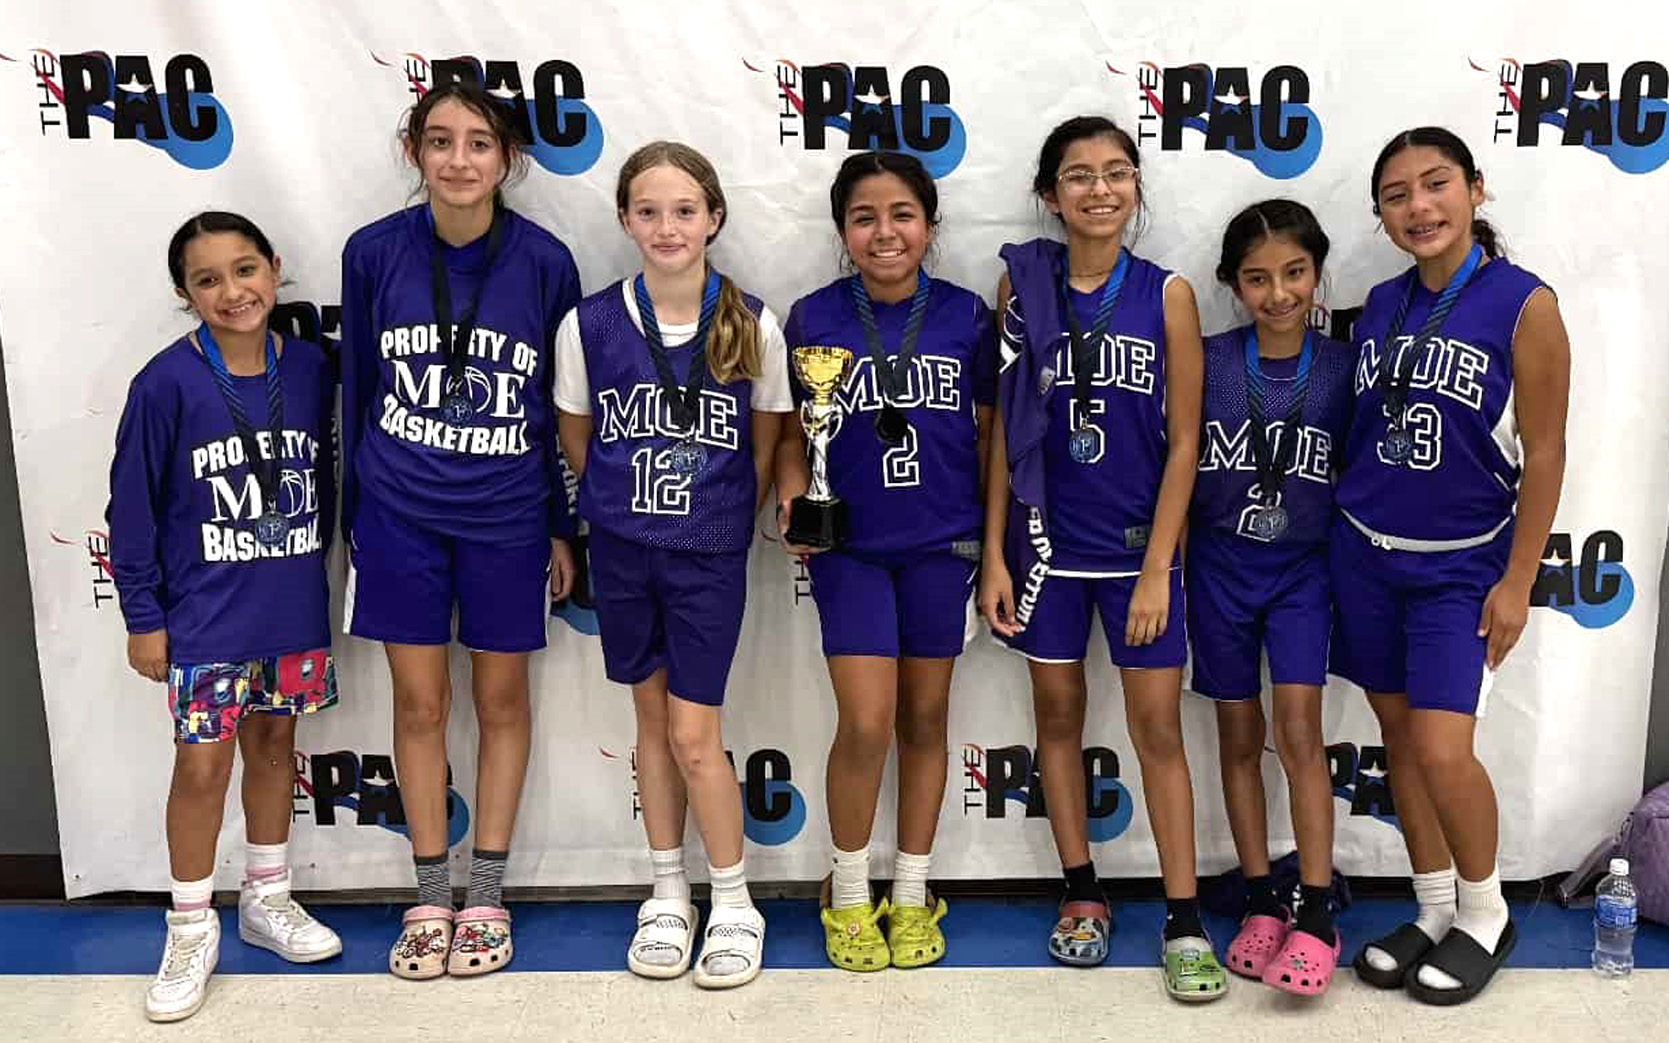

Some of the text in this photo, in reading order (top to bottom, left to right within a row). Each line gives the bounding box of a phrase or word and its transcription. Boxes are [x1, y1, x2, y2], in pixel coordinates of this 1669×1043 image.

[33, 50, 218, 142] THE PAC
[776, 61, 951, 152] THE PAC
[1137, 62, 1310, 152] THE PAC
[1493, 58, 1669, 148] THE PAC
[512, 341, 538, 377] OF
[191, 429, 307, 480] PROETY
[379, 393, 532, 456] BASKETBALL
[882, 423, 921, 488] 2
[1069, 398, 1106, 464] 5
[631, 447, 691, 516] 12
[201, 512, 322, 562] BASTBAL
[1529, 529, 1624, 607] AC
[88, 536, 114, 609] THE
[964, 747, 983, 817] THE
